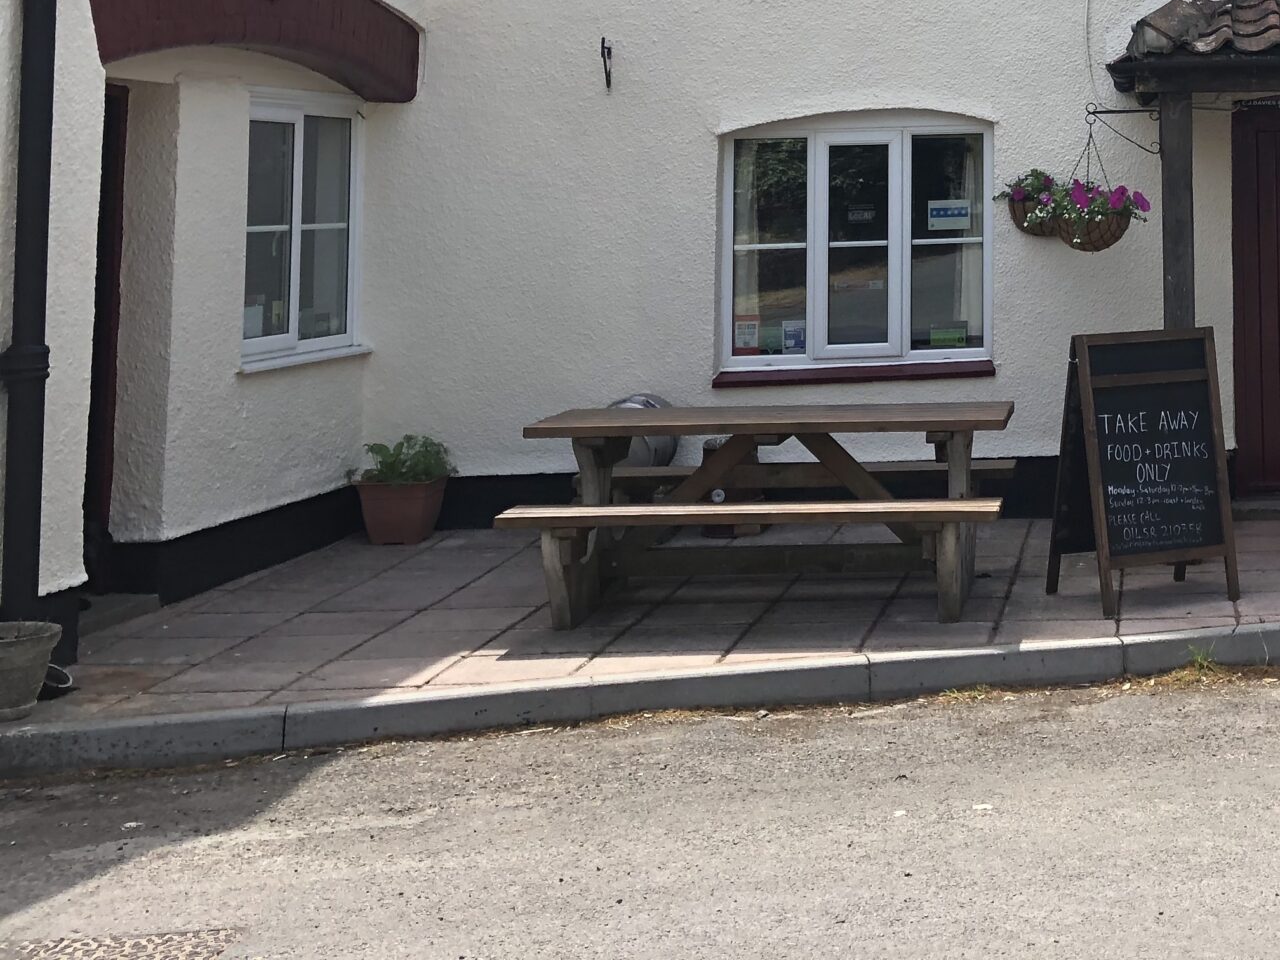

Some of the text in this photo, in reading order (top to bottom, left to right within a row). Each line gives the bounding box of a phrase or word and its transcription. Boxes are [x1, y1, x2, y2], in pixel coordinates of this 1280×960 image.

[1097, 410, 1199, 434] TAKE AWAY
[1107, 443, 1142, 462] FOOD
[1154, 441, 1209, 460] DRINKS
[1136, 463, 1171, 483] ONLY
[1107, 485, 1136, 497] Monday
[1107, 510, 1161, 527] PLEASE CALL
